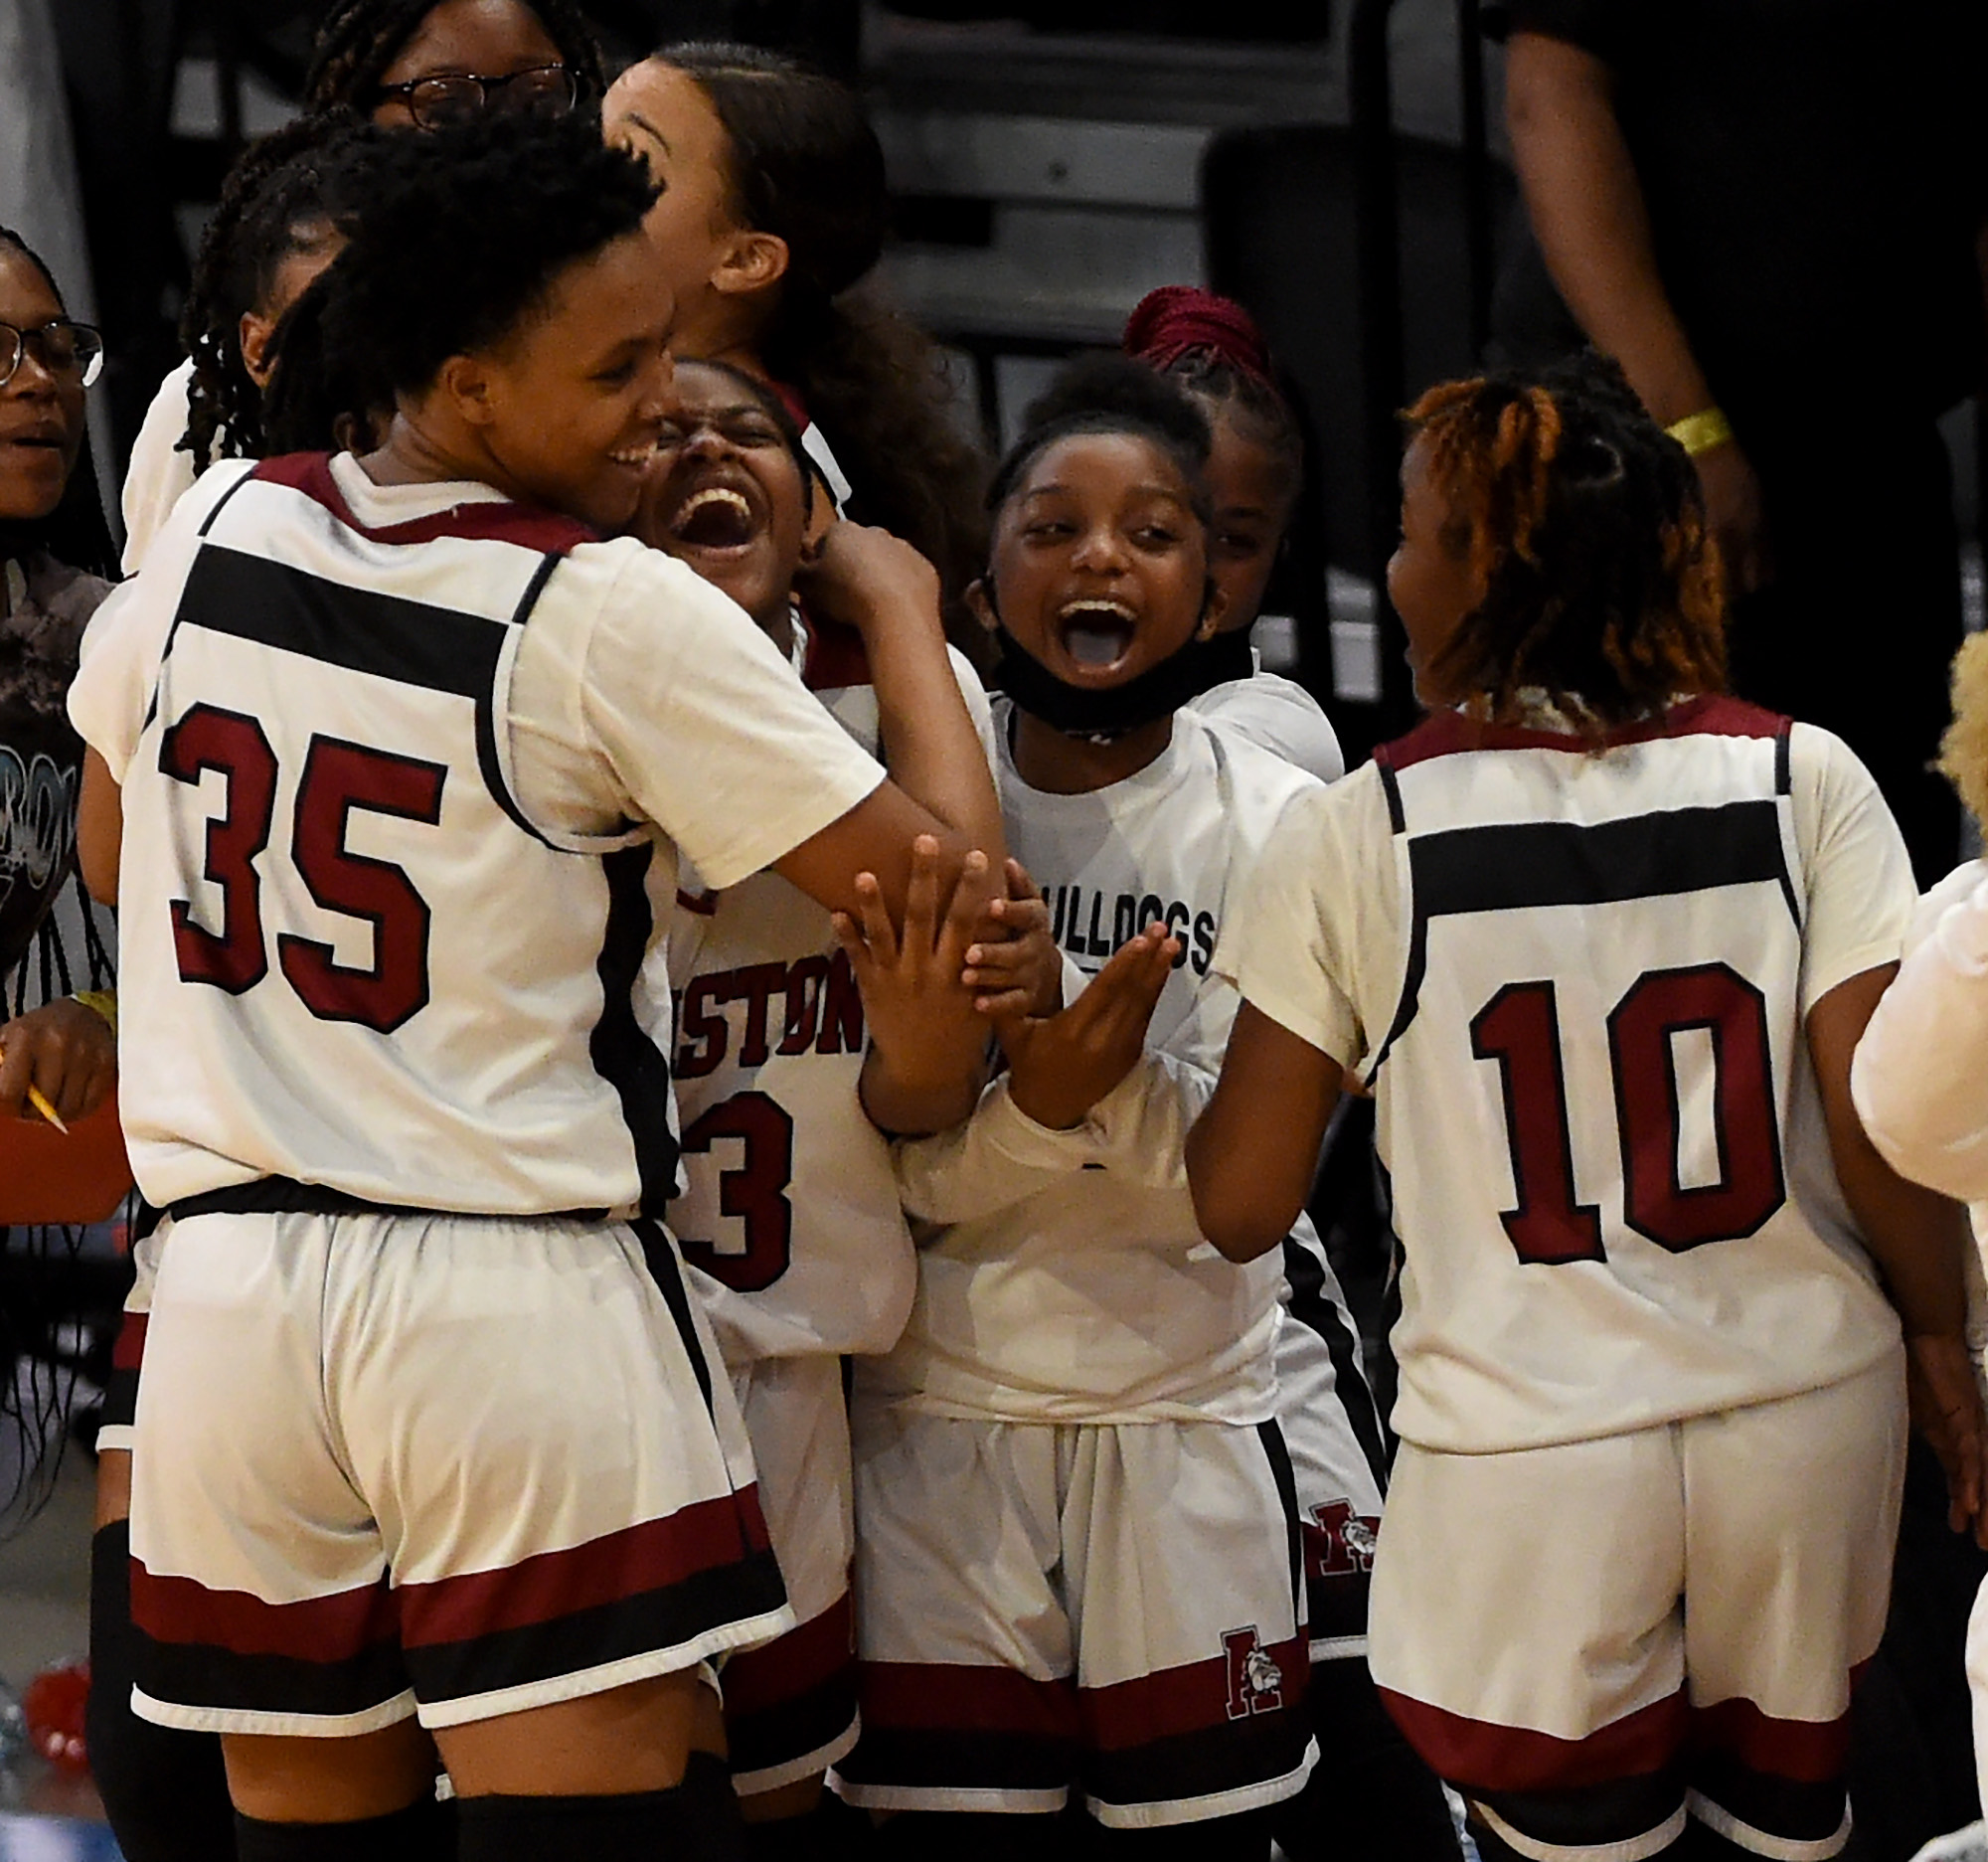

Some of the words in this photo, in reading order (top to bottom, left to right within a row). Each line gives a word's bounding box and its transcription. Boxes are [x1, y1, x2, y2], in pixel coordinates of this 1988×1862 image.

[158, 701, 448, 1035] 35
[671, 946, 864, 1080] STON
[1469, 960, 1786, 1266] 10
